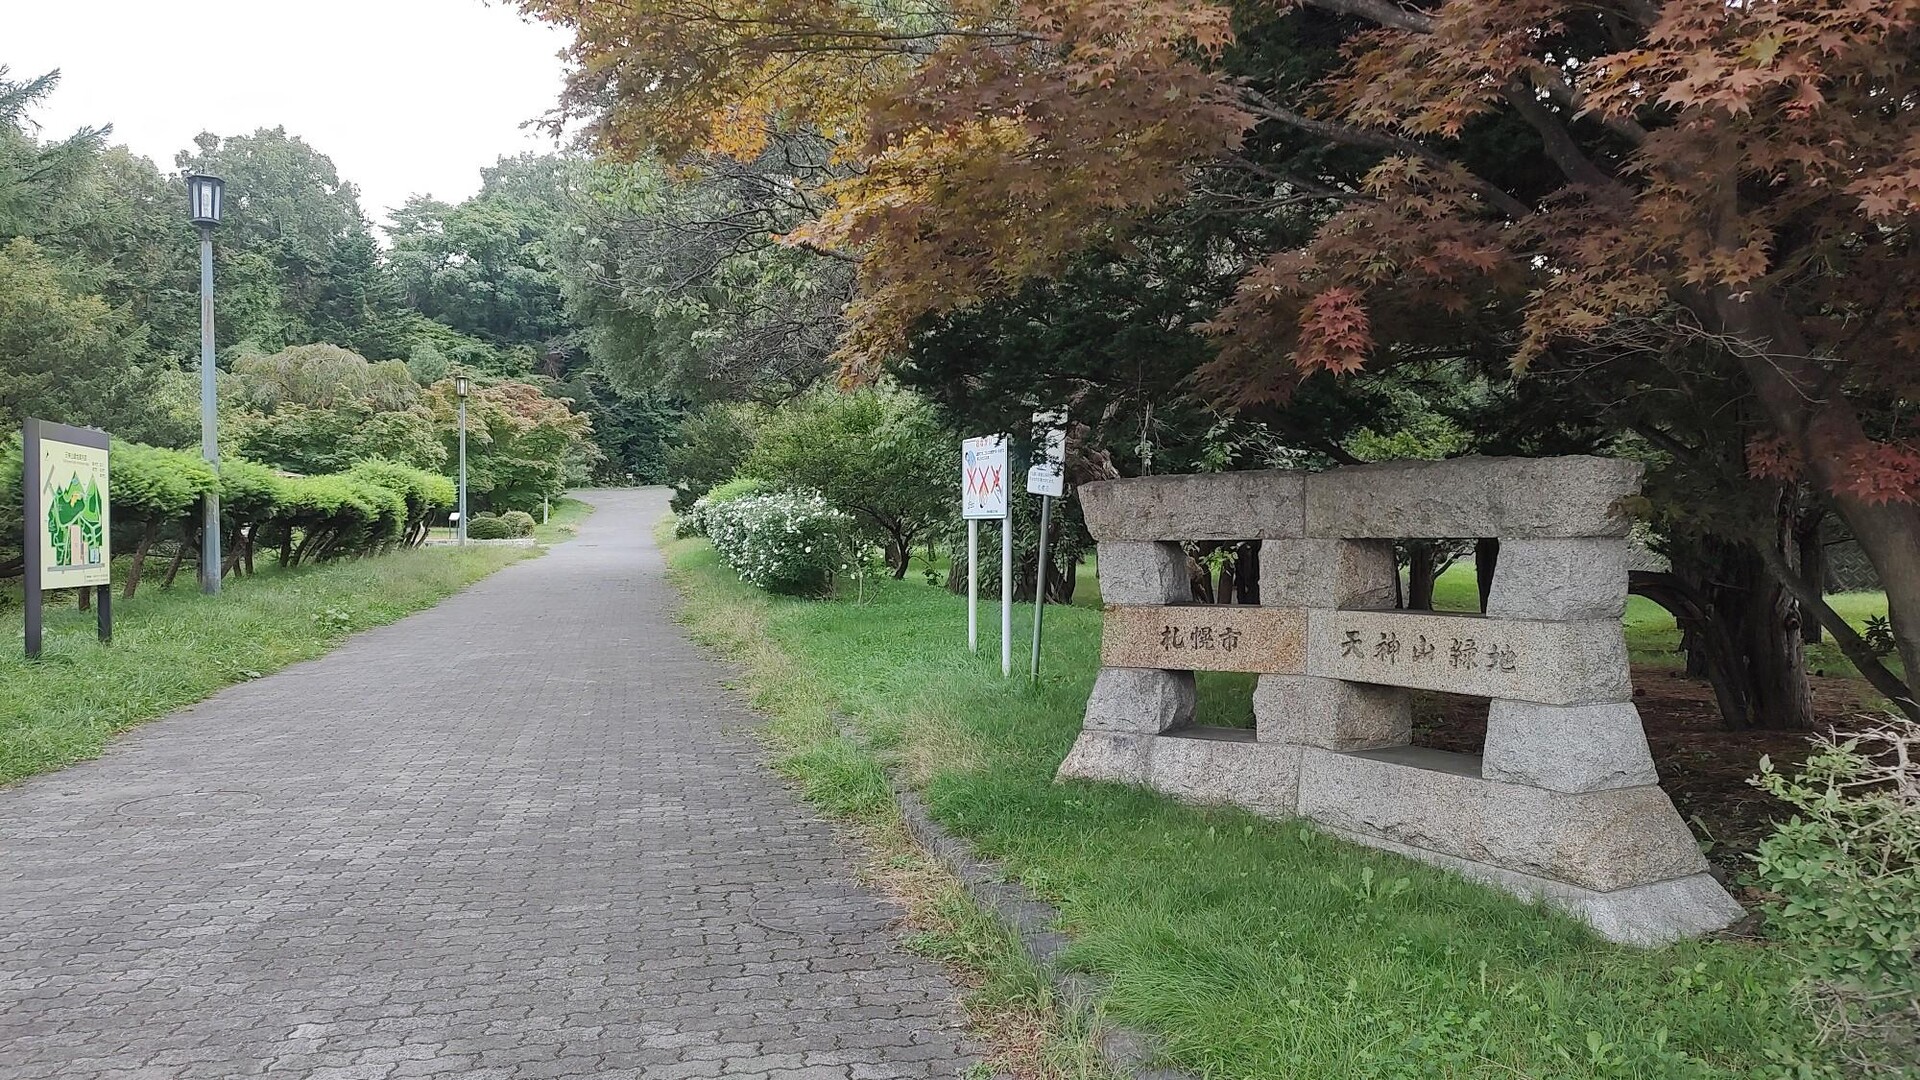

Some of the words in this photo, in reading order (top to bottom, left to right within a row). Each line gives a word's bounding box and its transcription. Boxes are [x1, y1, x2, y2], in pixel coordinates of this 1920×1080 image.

[1160, 625, 1242, 650] 札幌市
[1341, 630, 1517, 673] 天神山緑地
